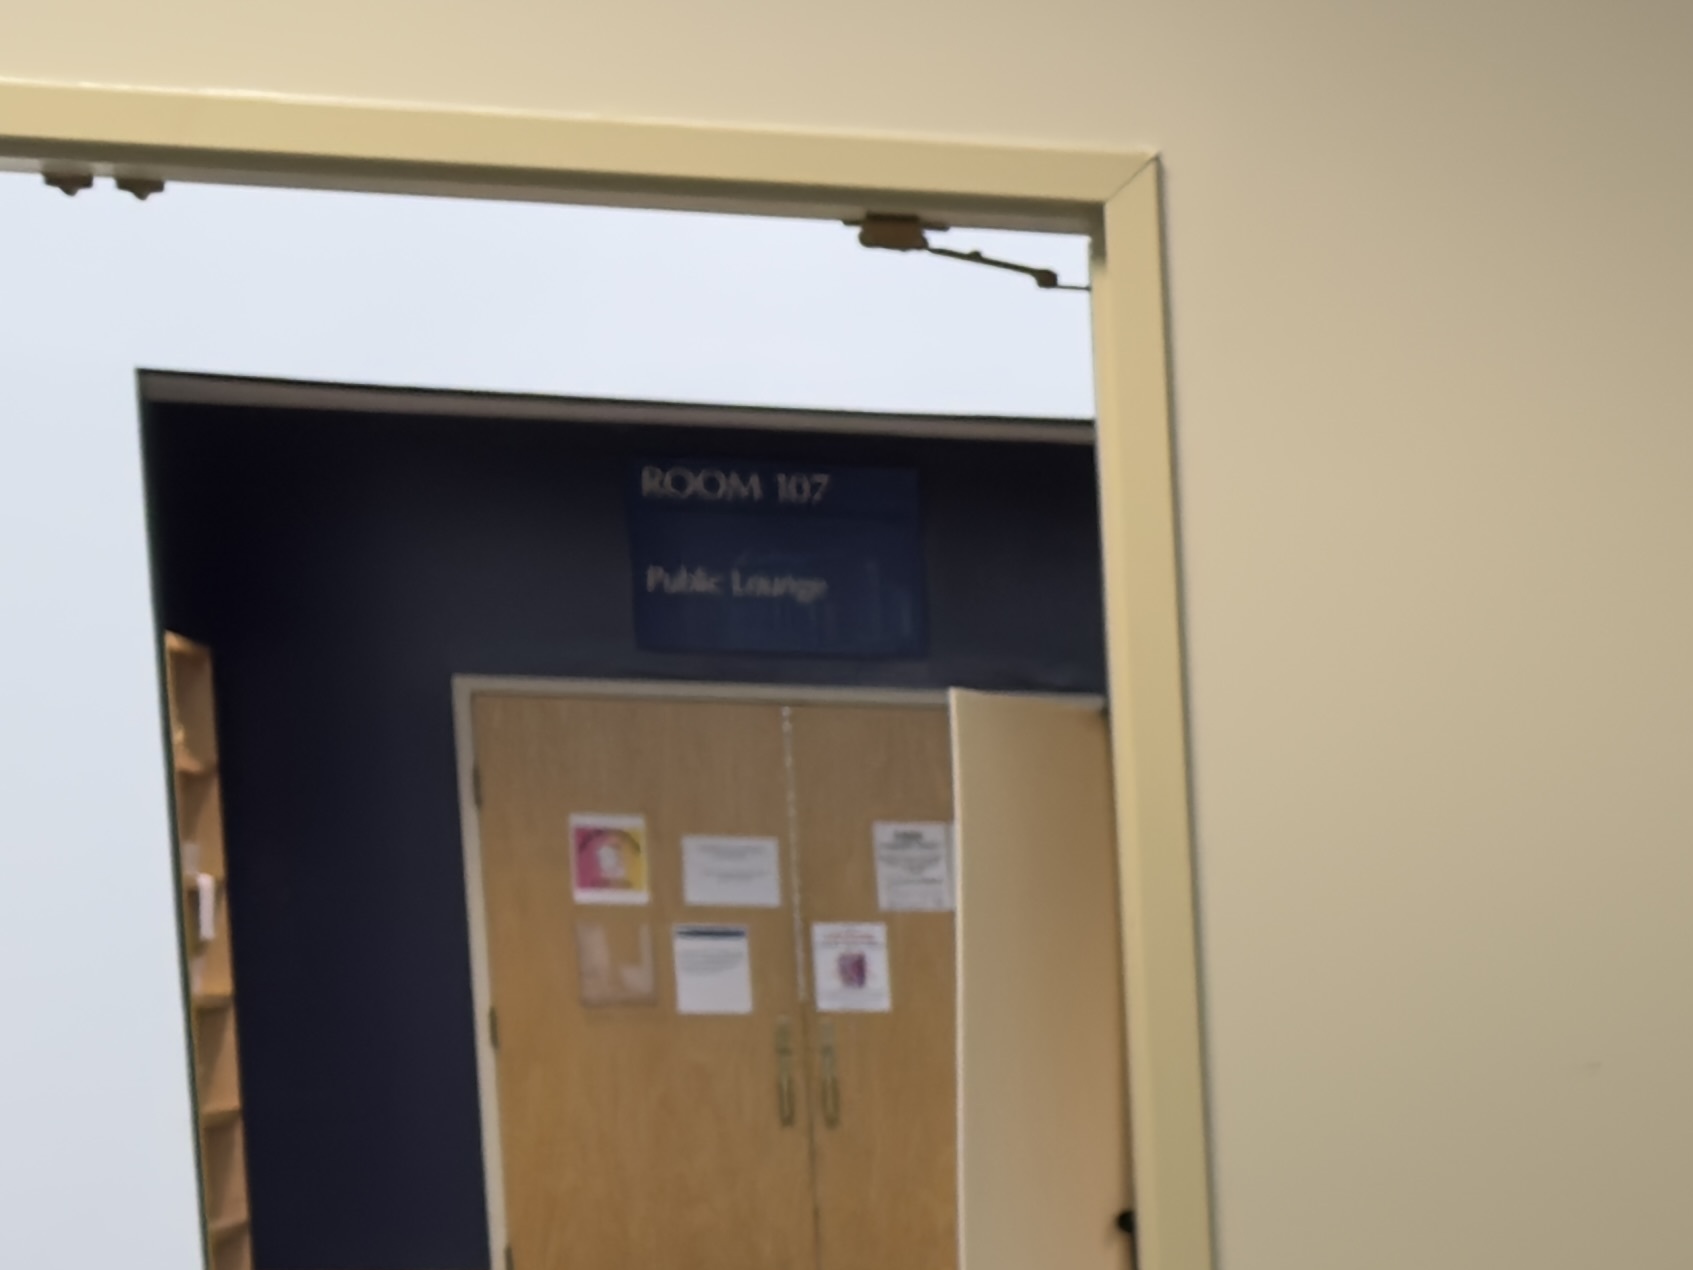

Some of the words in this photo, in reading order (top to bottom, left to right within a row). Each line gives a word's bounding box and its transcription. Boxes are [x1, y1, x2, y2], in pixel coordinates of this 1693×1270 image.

[641, 466, 763, 501] ROOM
[777, 473, 830, 503] 107
[646, 564, 720, 593] Public
[731, 569, 828, 602] Lounge
